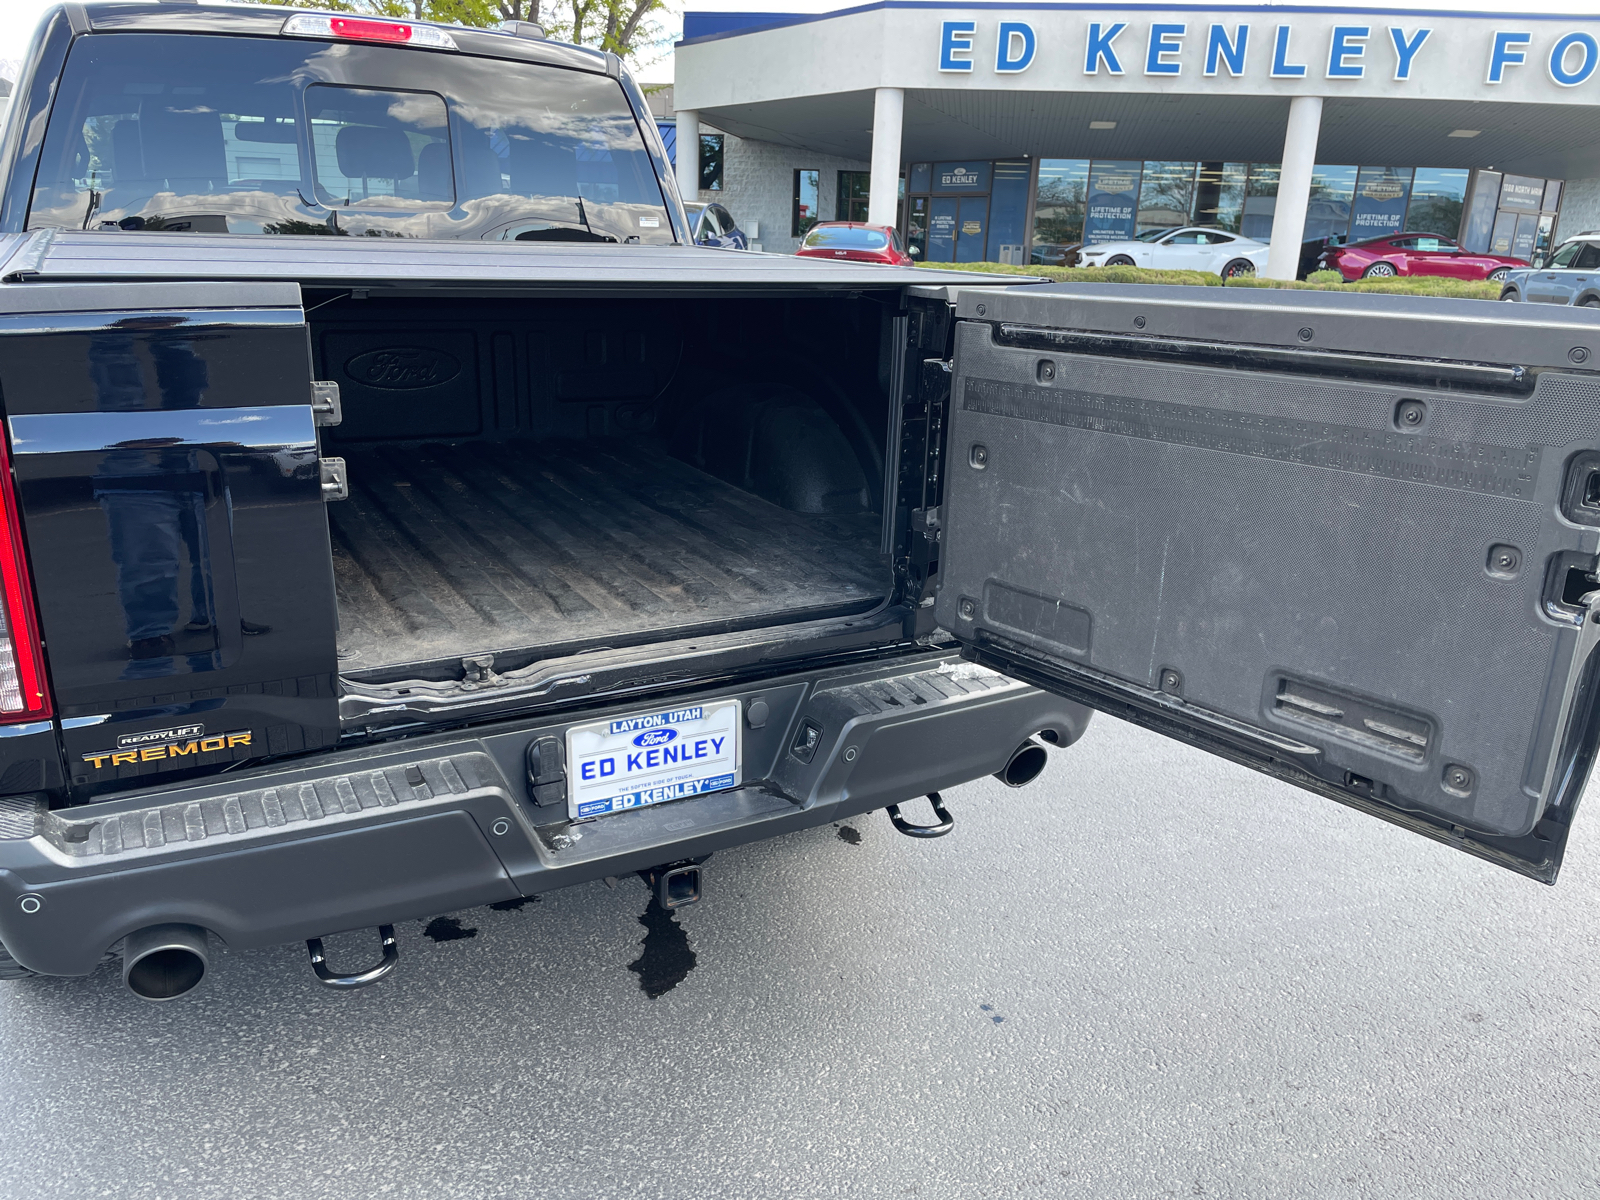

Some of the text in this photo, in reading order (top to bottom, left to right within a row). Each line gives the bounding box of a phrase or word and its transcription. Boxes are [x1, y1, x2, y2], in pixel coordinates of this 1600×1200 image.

[938, 20, 1600, 87] ED KENLEY FO
[952, 175, 978, 184] KENLEY
[366, 352, 437, 382] Ford
[122, 727, 200, 744] READYLIFT
[612, 708, 702, 733] LAYTON, UTAH
[84, 734, 252, 769] TREMOR
[641, 730, 670, 746] Ford
[581, 757, 615, 781] ED
[627, 736, 726, 772] KENLEY
[612, 795, 635, 810] ED
[640, 780, 703, 804] KENLEY
